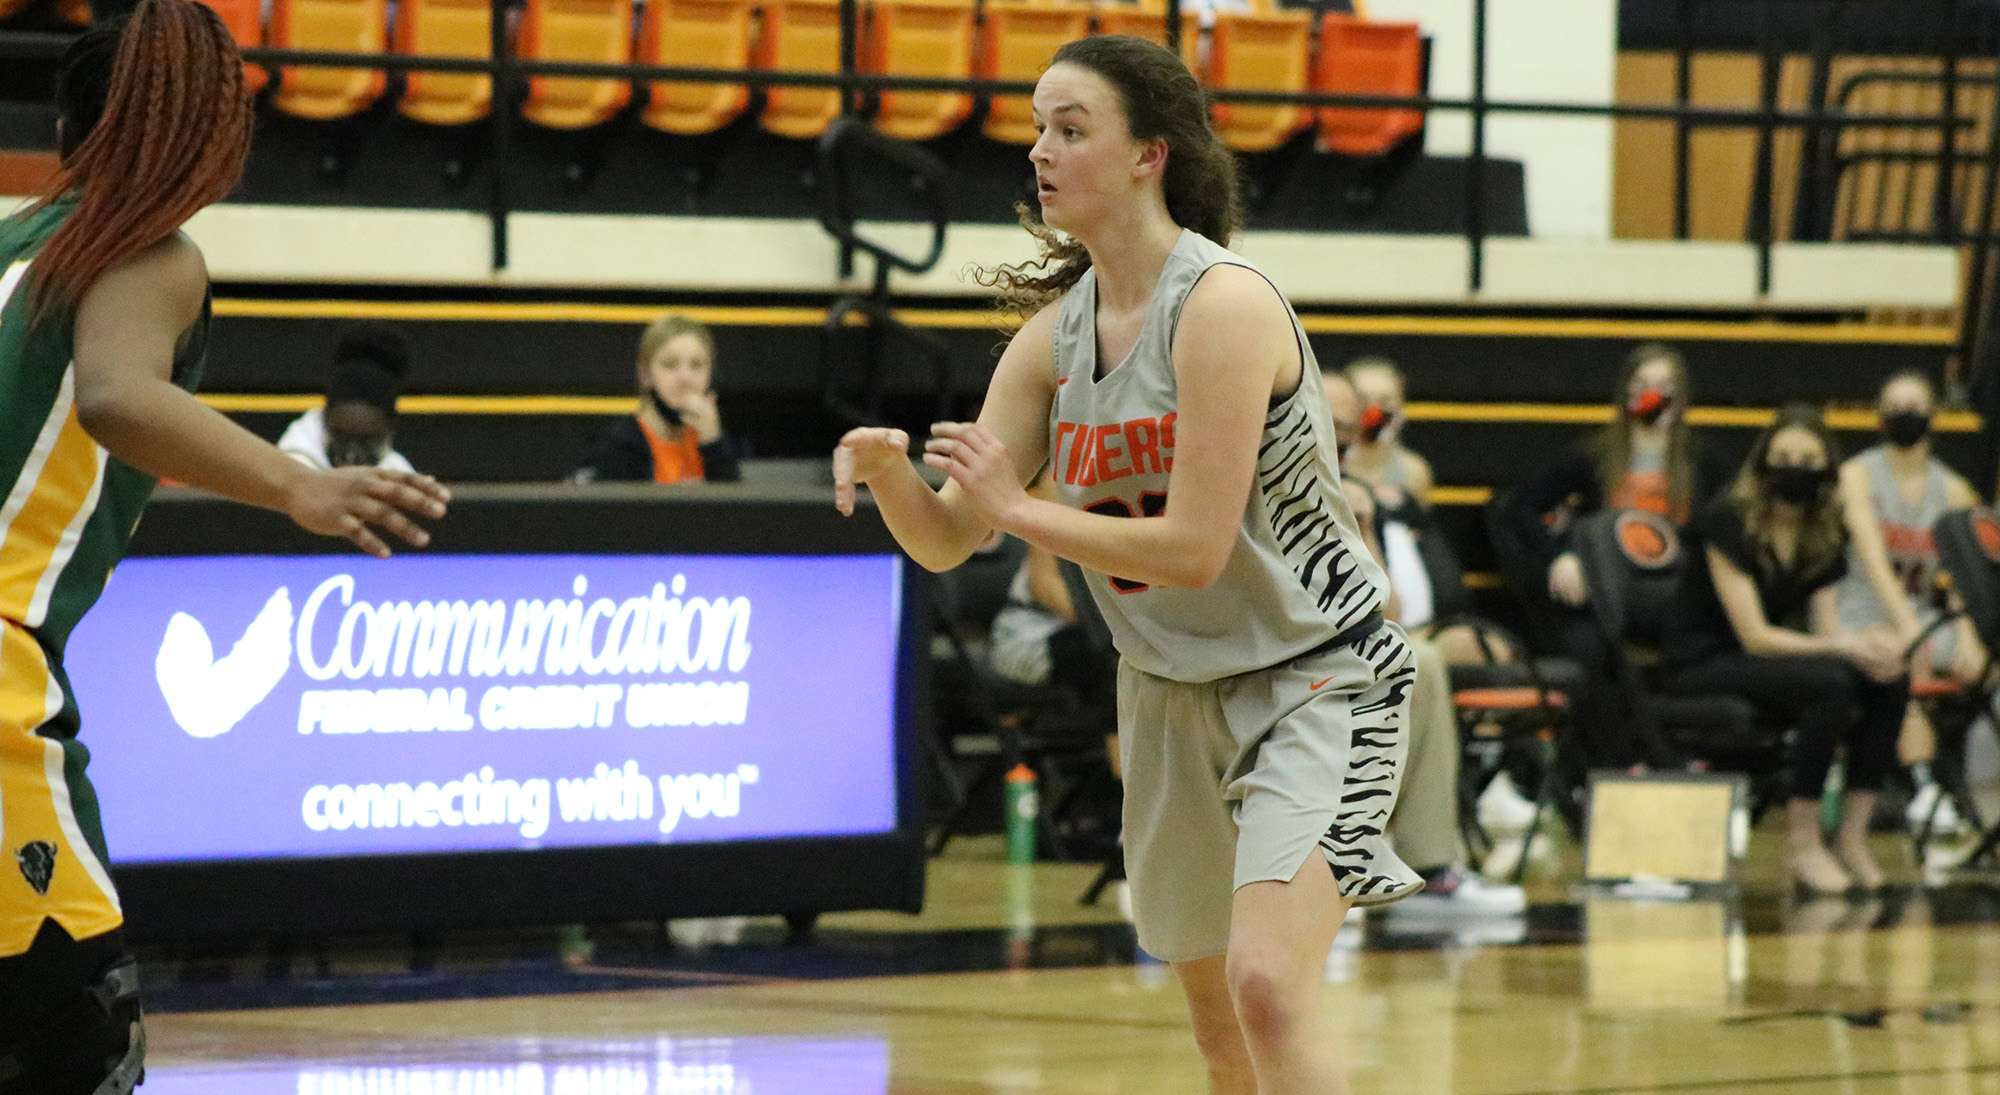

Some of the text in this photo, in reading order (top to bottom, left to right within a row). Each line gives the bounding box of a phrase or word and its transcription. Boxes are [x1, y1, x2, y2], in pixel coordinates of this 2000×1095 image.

[297, 574, 752, 680] Communication
[298, 681, 750, 734] FEDERAL CREDIT UNION
[302, 765, 550, 838] connecting
[556, 759, 653, 822] with
